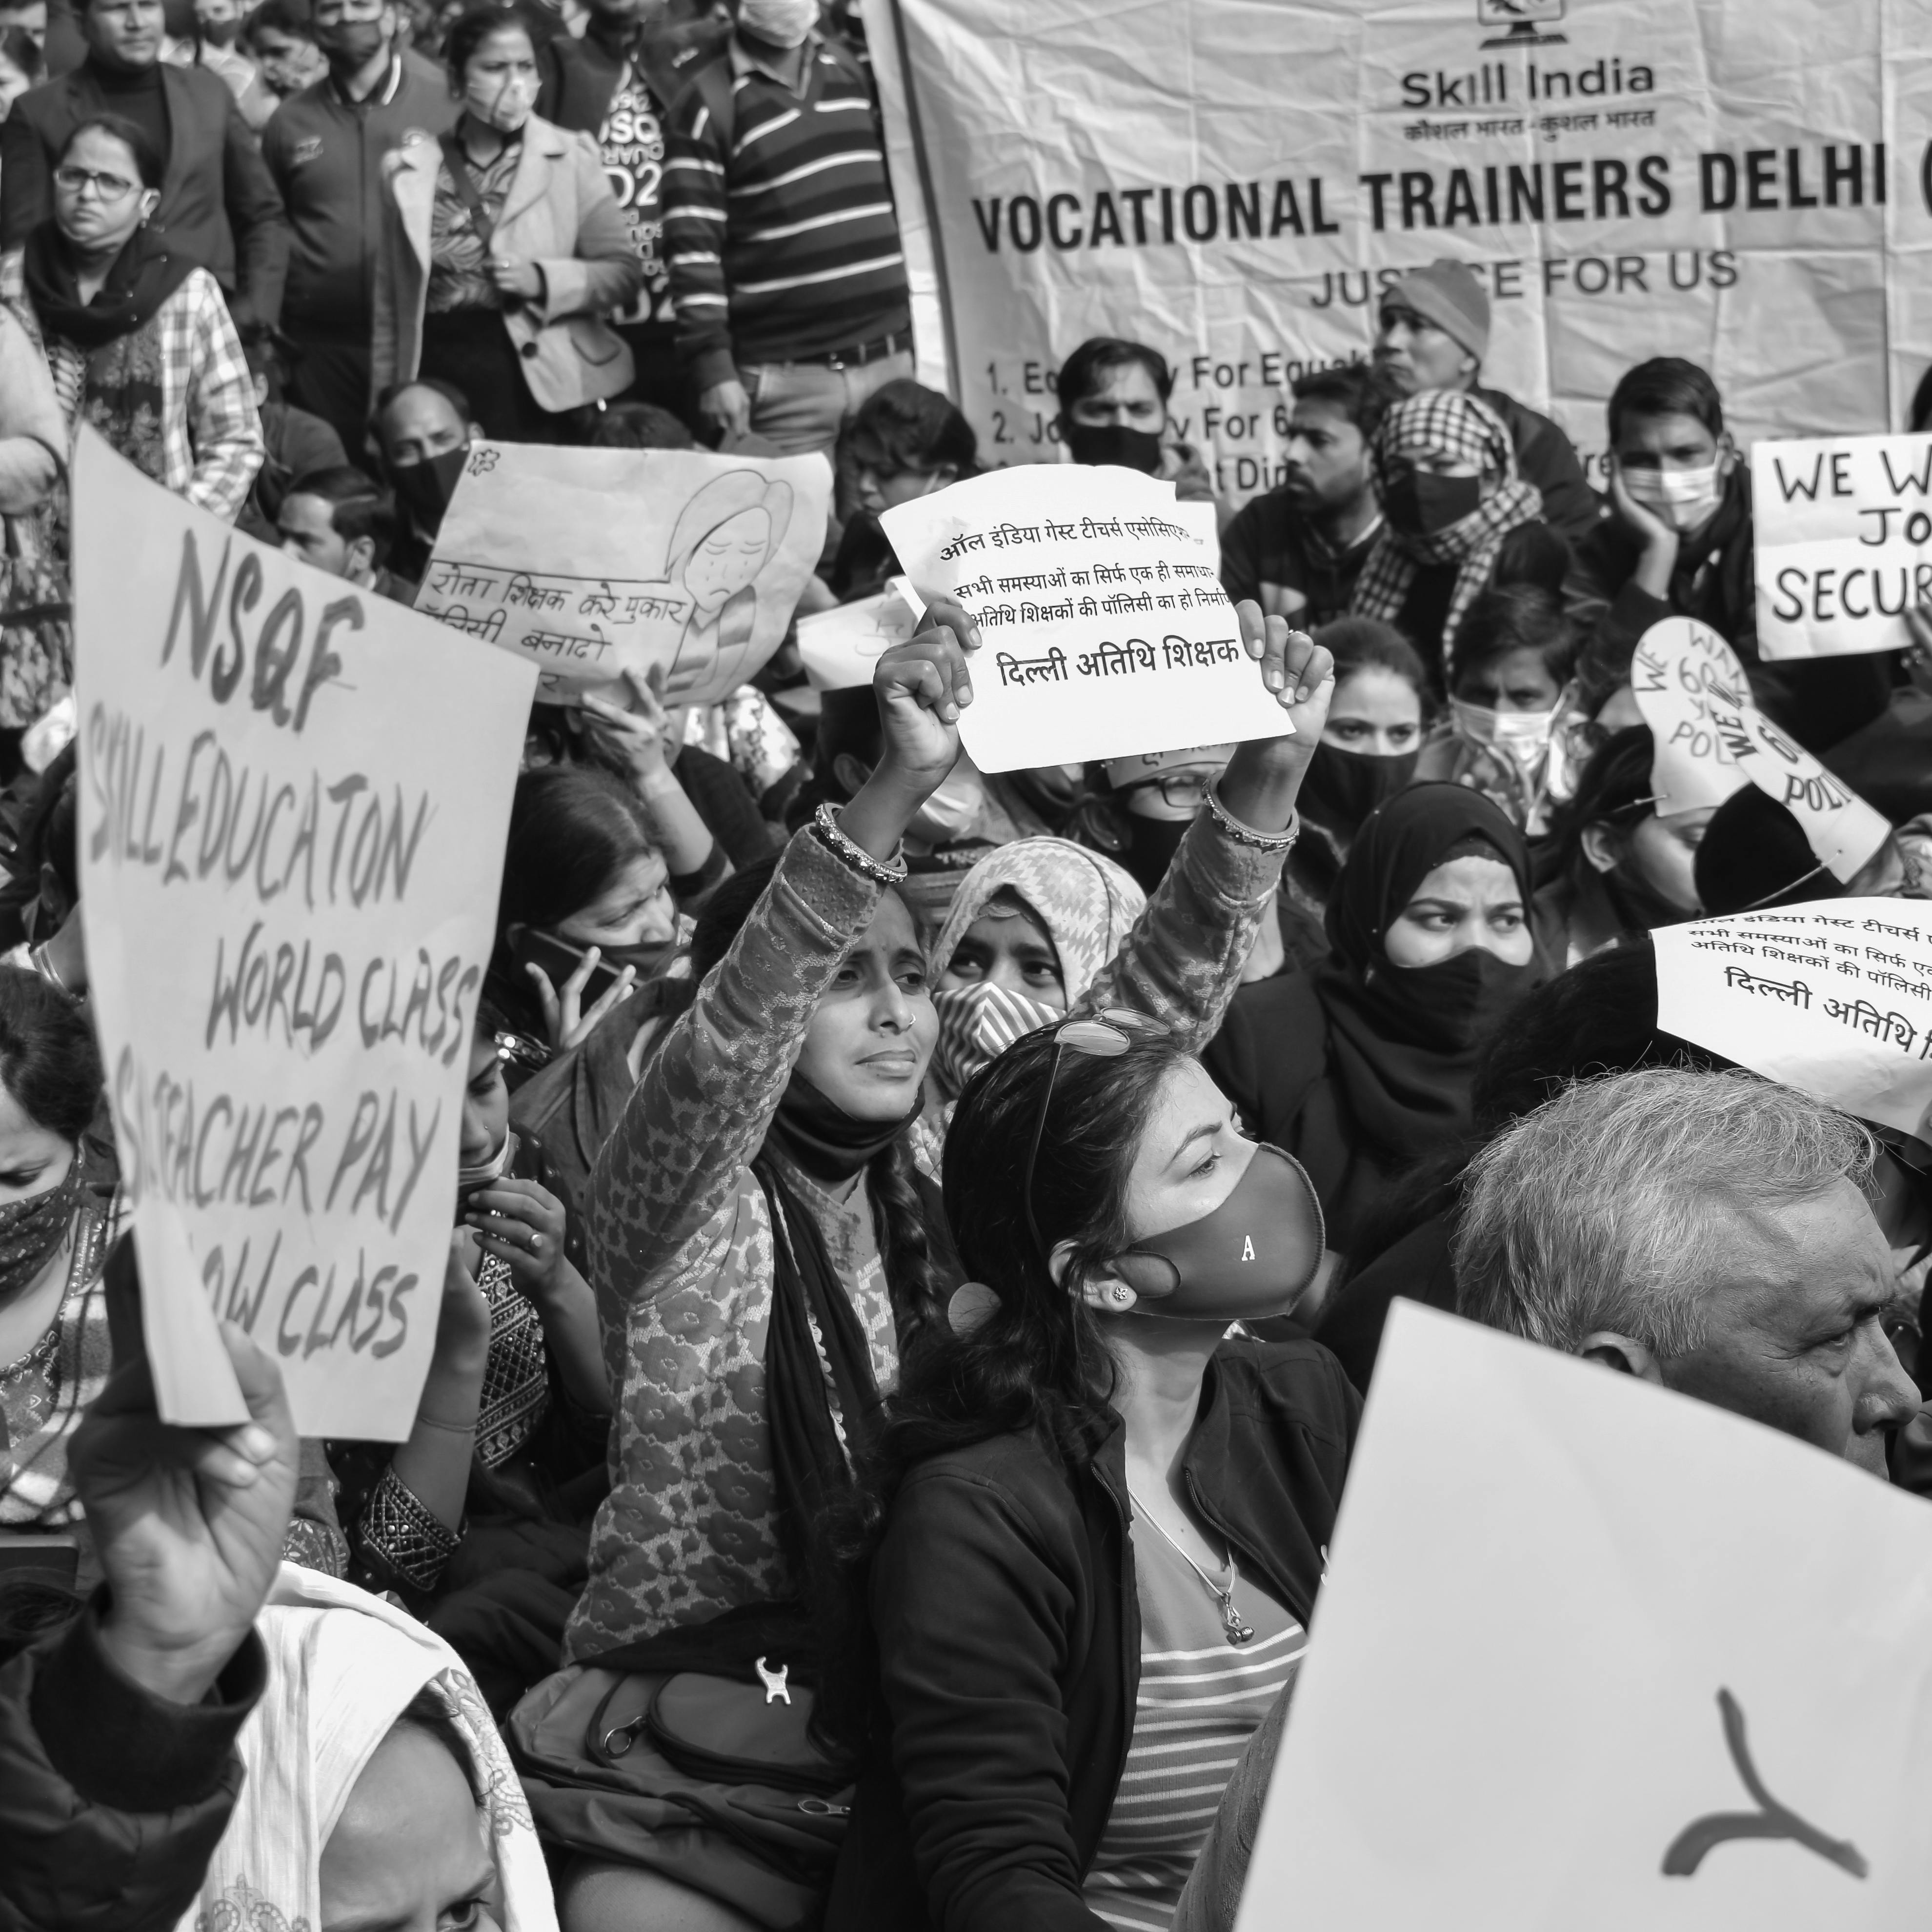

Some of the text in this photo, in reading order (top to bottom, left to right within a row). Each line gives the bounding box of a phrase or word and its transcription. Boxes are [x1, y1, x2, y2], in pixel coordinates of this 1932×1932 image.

[1401, 58, 1654, 108] Skill India
[1607, 110, 1655, 128] भारत
[971, 178, 1339, 254] VOCATIONAL
[1359, 155, 1672, 233] TRAINERS
[1700, 143, 1887, 214] DELHI
[1543, 255, 1650, 296] FOR
[1670, 250, 1738, 292] US
[986, 362, 1007, 395] 1.
[1192, 356, 1249, 389] For
[992, 411, 1014, 444] 2.
[1204, 407, 1259, 440] For
[1772, 452, 1853, 503] WE
[939, 533, 986, 562] ऑल
[989, 523, 1042, 549] इंडिया
[1045, 519, 1077, 542] गेस्ट
[1080, 517, 1123, 539] टीचर्स
[1858, 508, 1932, 545] JO
[954, 575, 994, 600] सभी
[998, 567, 1067, 592] समस्याओं
[1070, 570, 1090, 586] का
[1093, 563, 1126, 584] सिर्फ
[1128, 566, 1153, 585] एक
[1155, 560, 1171, 582] ही
[1021, 598, 1074, 624] शिक्षकों
[1078, 596, 1098, 618] की
[1101, 591, 1153, 615] पॉलिसी
[1156, 595, 1176, 609] का
[1178, 588, 1193, 610] हो
[160, 527, 366, 733] NSQF
[996, 634, 1240, 686] दिल्ली अतिथि शिक्षक
[1688, 928, 1730, 937] सभी
[1736, 931, 1828, 950] समस्याओं
[1834, 942, 1859, 957] का
[1865, 946, 1907, 968] सिर्फ
[1811, 915, 1855, 928] गेस्ट
[1861, 919, 1920, 942] टीचर्स
[205, 917, 480, 1068] WORLD CLASS
[1690, 941, 1932, 1001] अतिथि शिक्षकों की पॉलिसी
[1723, 966, 1813, 1009] दिल्ली
[1823, 999, 1918, 1053] अतिथि
[324, 1088, 442, 1237] PAY
[1241, 1235, 1255, 1261] A
[276, 1247, 420, 1360] CLASS
